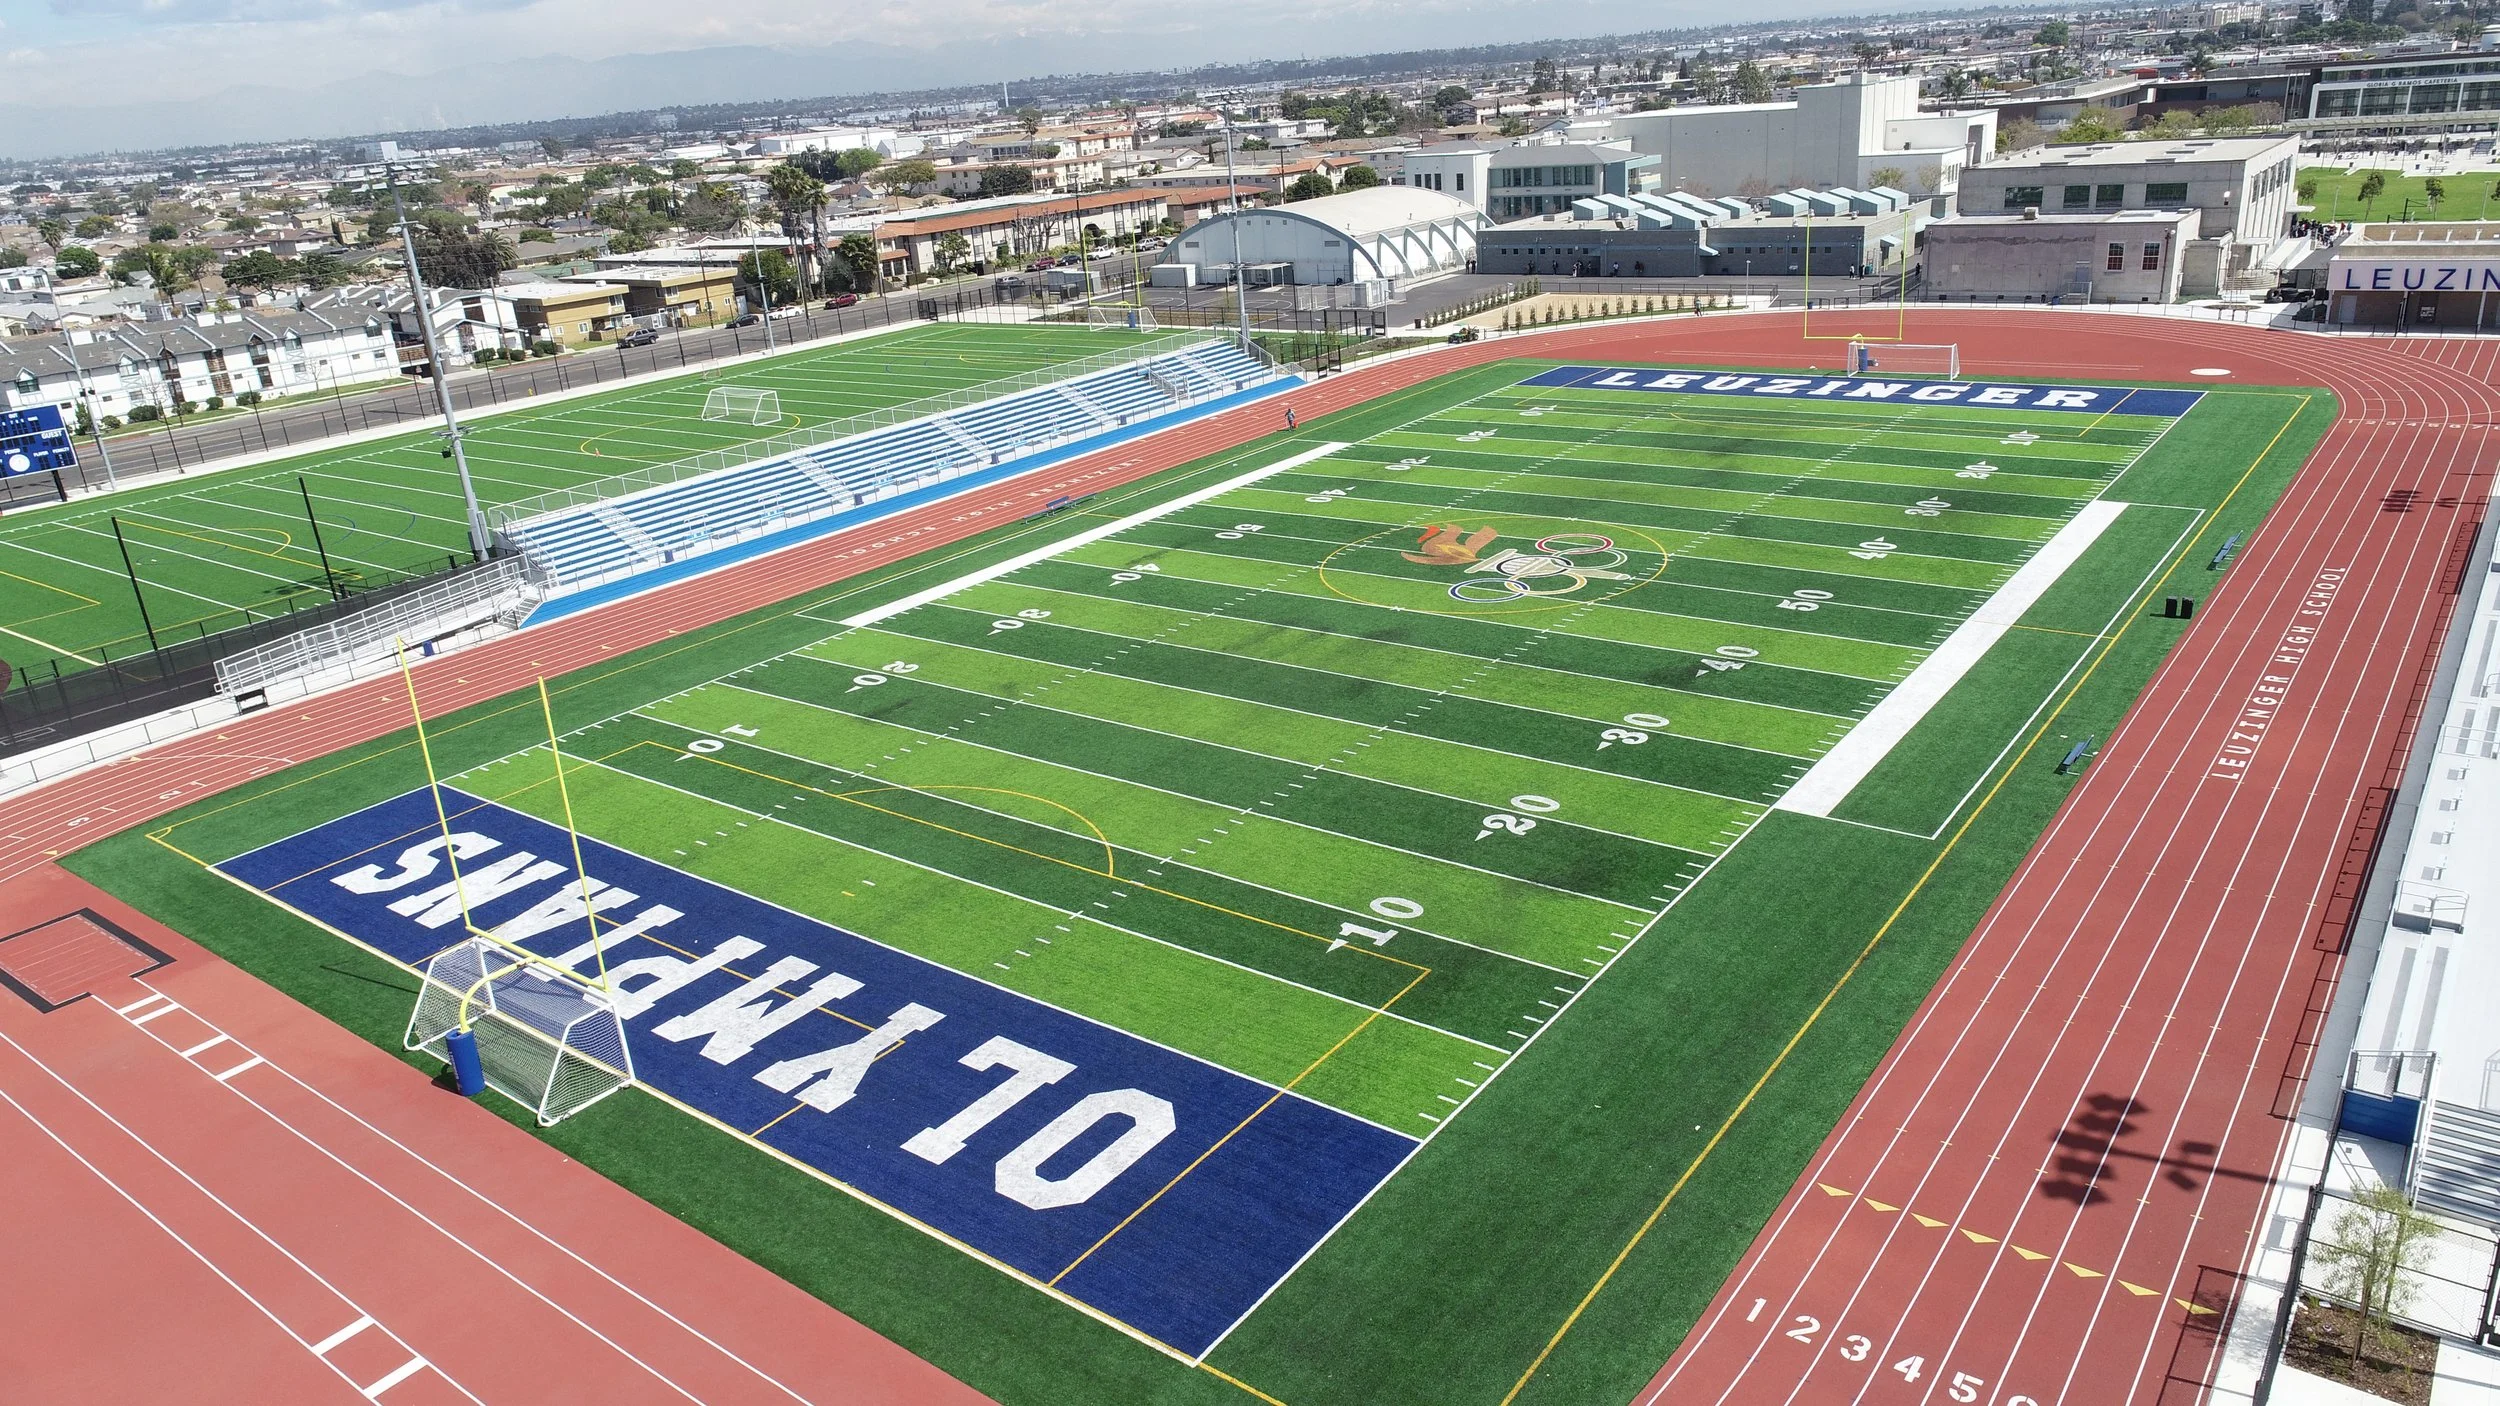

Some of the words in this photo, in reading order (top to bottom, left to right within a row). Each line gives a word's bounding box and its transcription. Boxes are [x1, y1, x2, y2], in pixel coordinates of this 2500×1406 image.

[1593, 371, 2101, 409] LEUZINGER
[41, 431, 62, 439] GUEST
[2000, 433, 2041, 446] 10
[1954, 464, 1999, 480] 20
[1904, 499, 1952, 517] 30
[834, 525, 937, 560] SCHOOL
[1215, 523, 1266, 539] 50
[1848, 540, 1898, 560] 40
[1111, 563, 1161, 581] 40
[1776, 589, 1834, 612] 50
[992, 608, 1052, 629] 30
[1701, 645, 1760, 671] 40
[853, 660, 920, 686] 20
[2211, 675, 2290, 780] LEUZINGER
[2274, 625, 2316, 664] HIGH
[2301, 567, 2346, 616] SCHOOL
[687, 723, 761, 753] 10
[1601, 713, 1670, 745] 30
[1483, 794, 1560, 836] 20
[1339, 896, 1425, 947] 10
[329, 830, 1178, 1211] OLYMPIANS
[1744, 1297, 1767, 1323] 1
[1785, 1314, 1821, 1344] 2
[1840, 1334, 1872, 1362] 3
[1894, 1354, 1925, 1383] 4
[1948, 1371, 1984, 1403] 5
